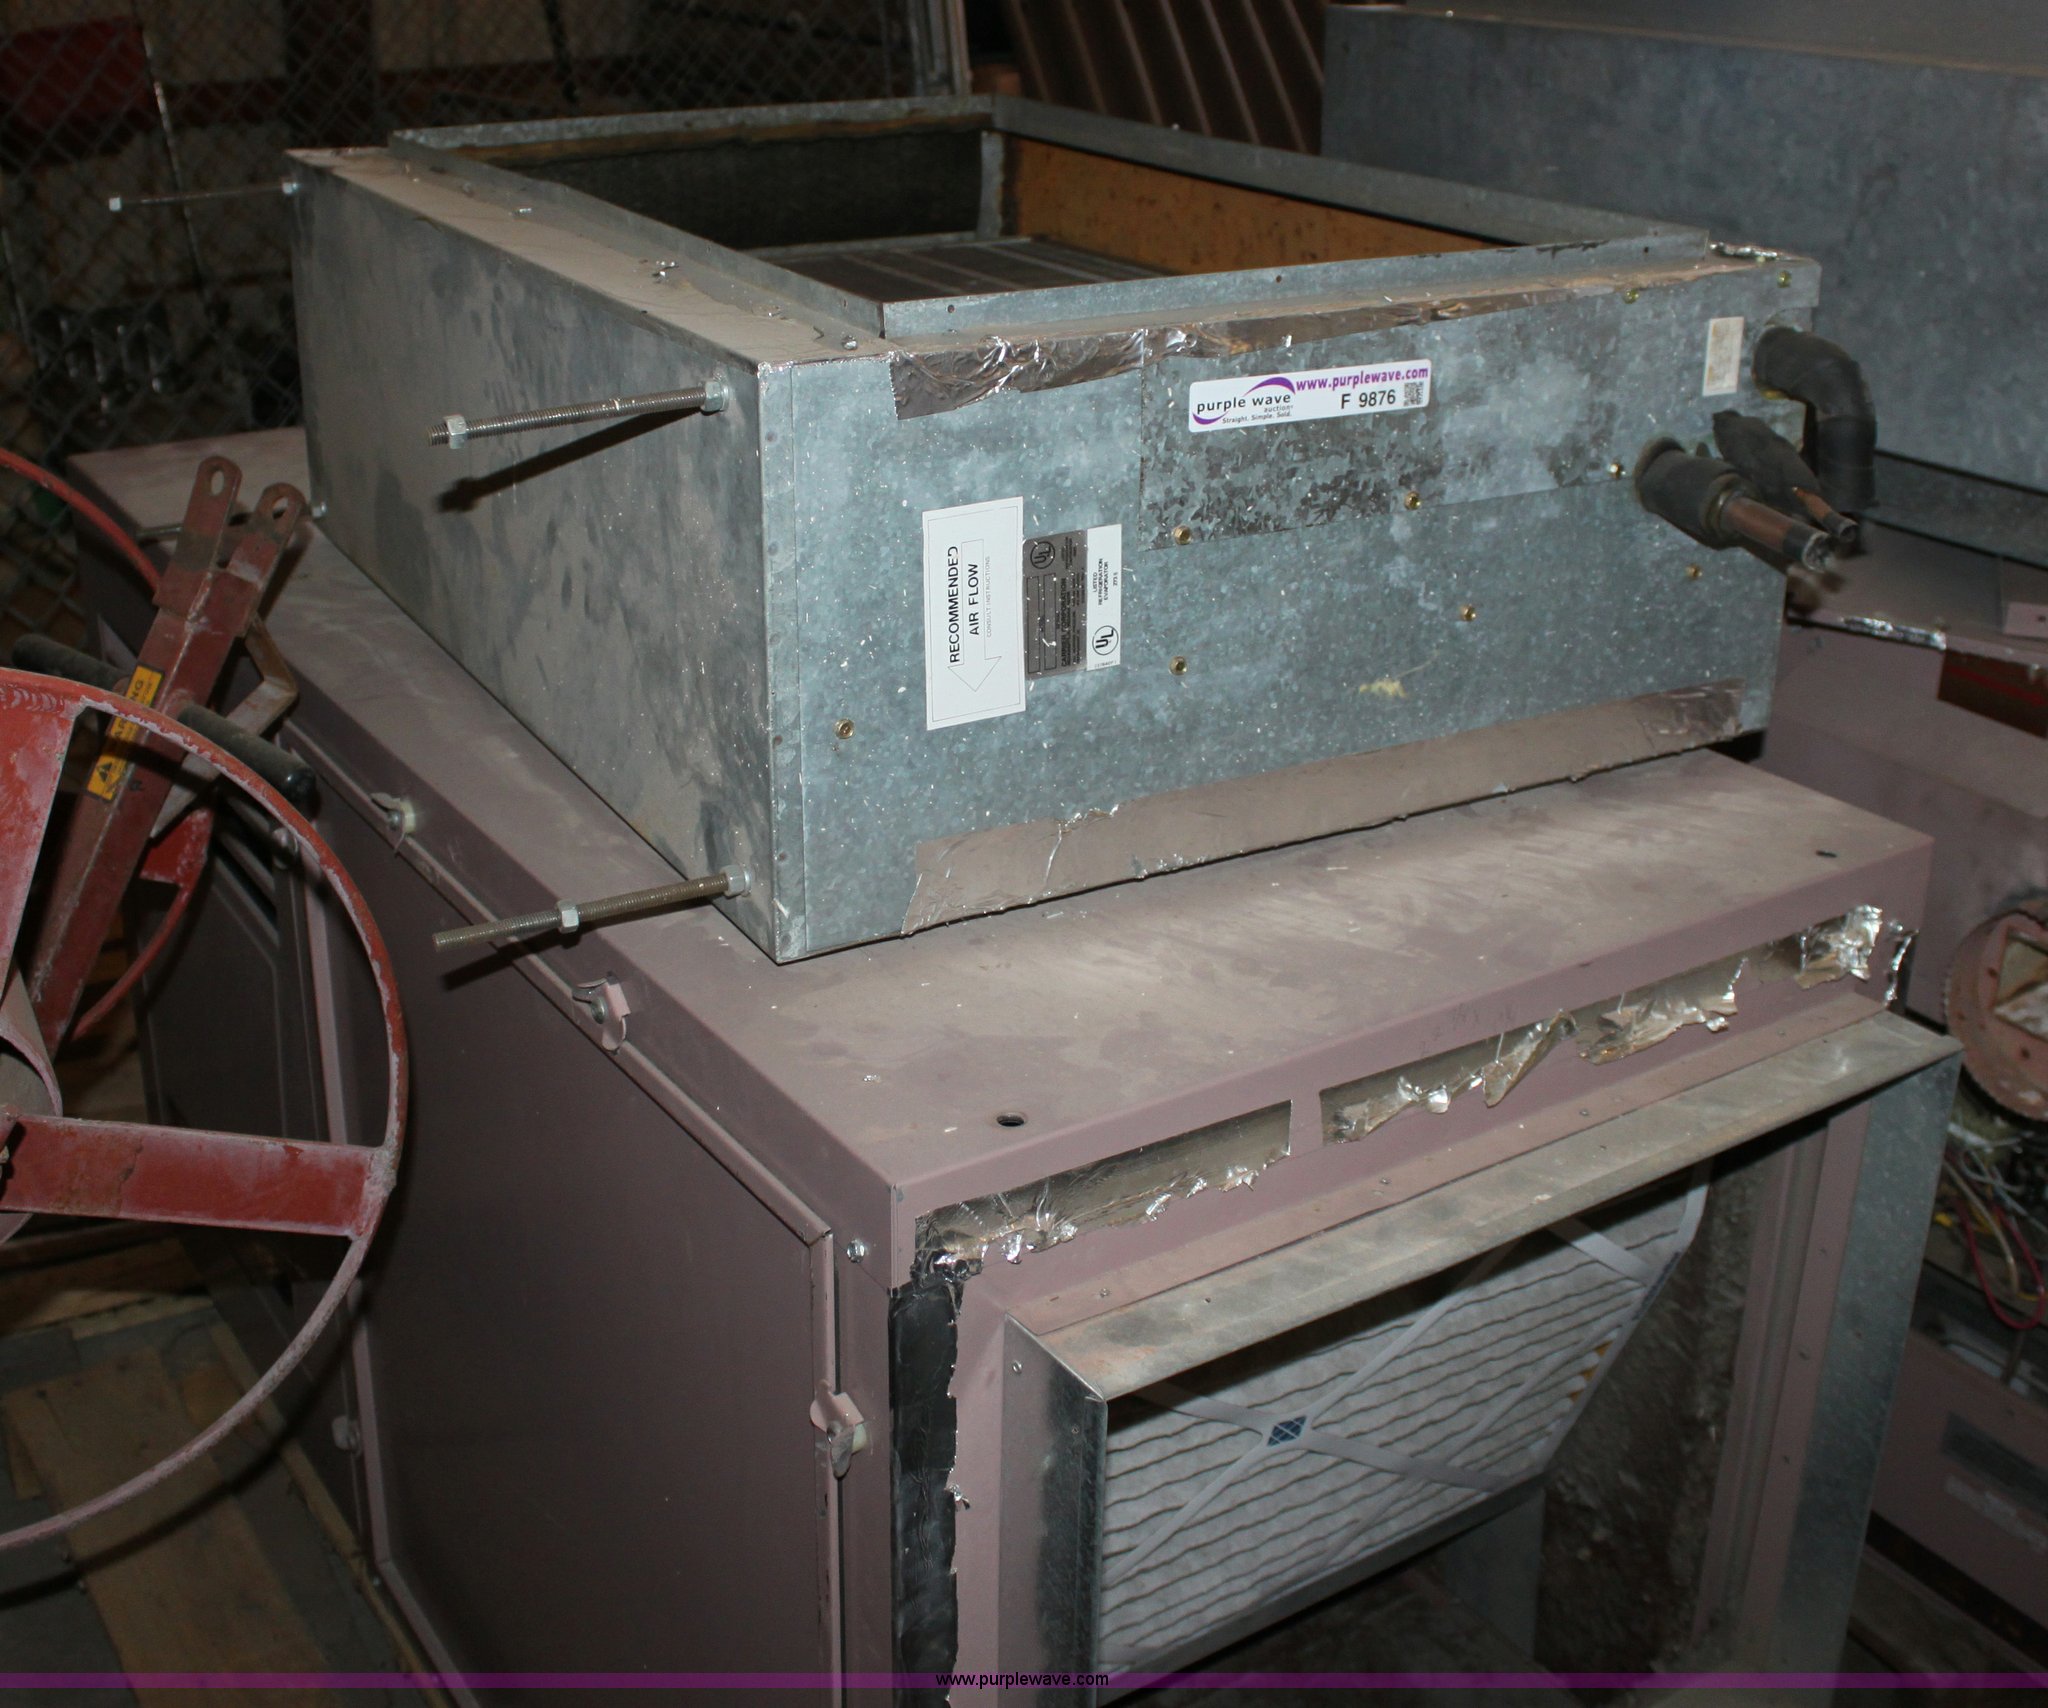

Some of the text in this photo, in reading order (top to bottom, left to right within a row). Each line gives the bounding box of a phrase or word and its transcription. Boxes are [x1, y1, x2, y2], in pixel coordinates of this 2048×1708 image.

[1296, 368, 1428, 391] www.purplewave.com
[1197, 394, 1291, 414] purple wave
[1341, 389, 1396, 409] F 9876
[947, 546, 960, 663] RECOMMENDED
[967, 564, 980, 635] AIR FLOW
